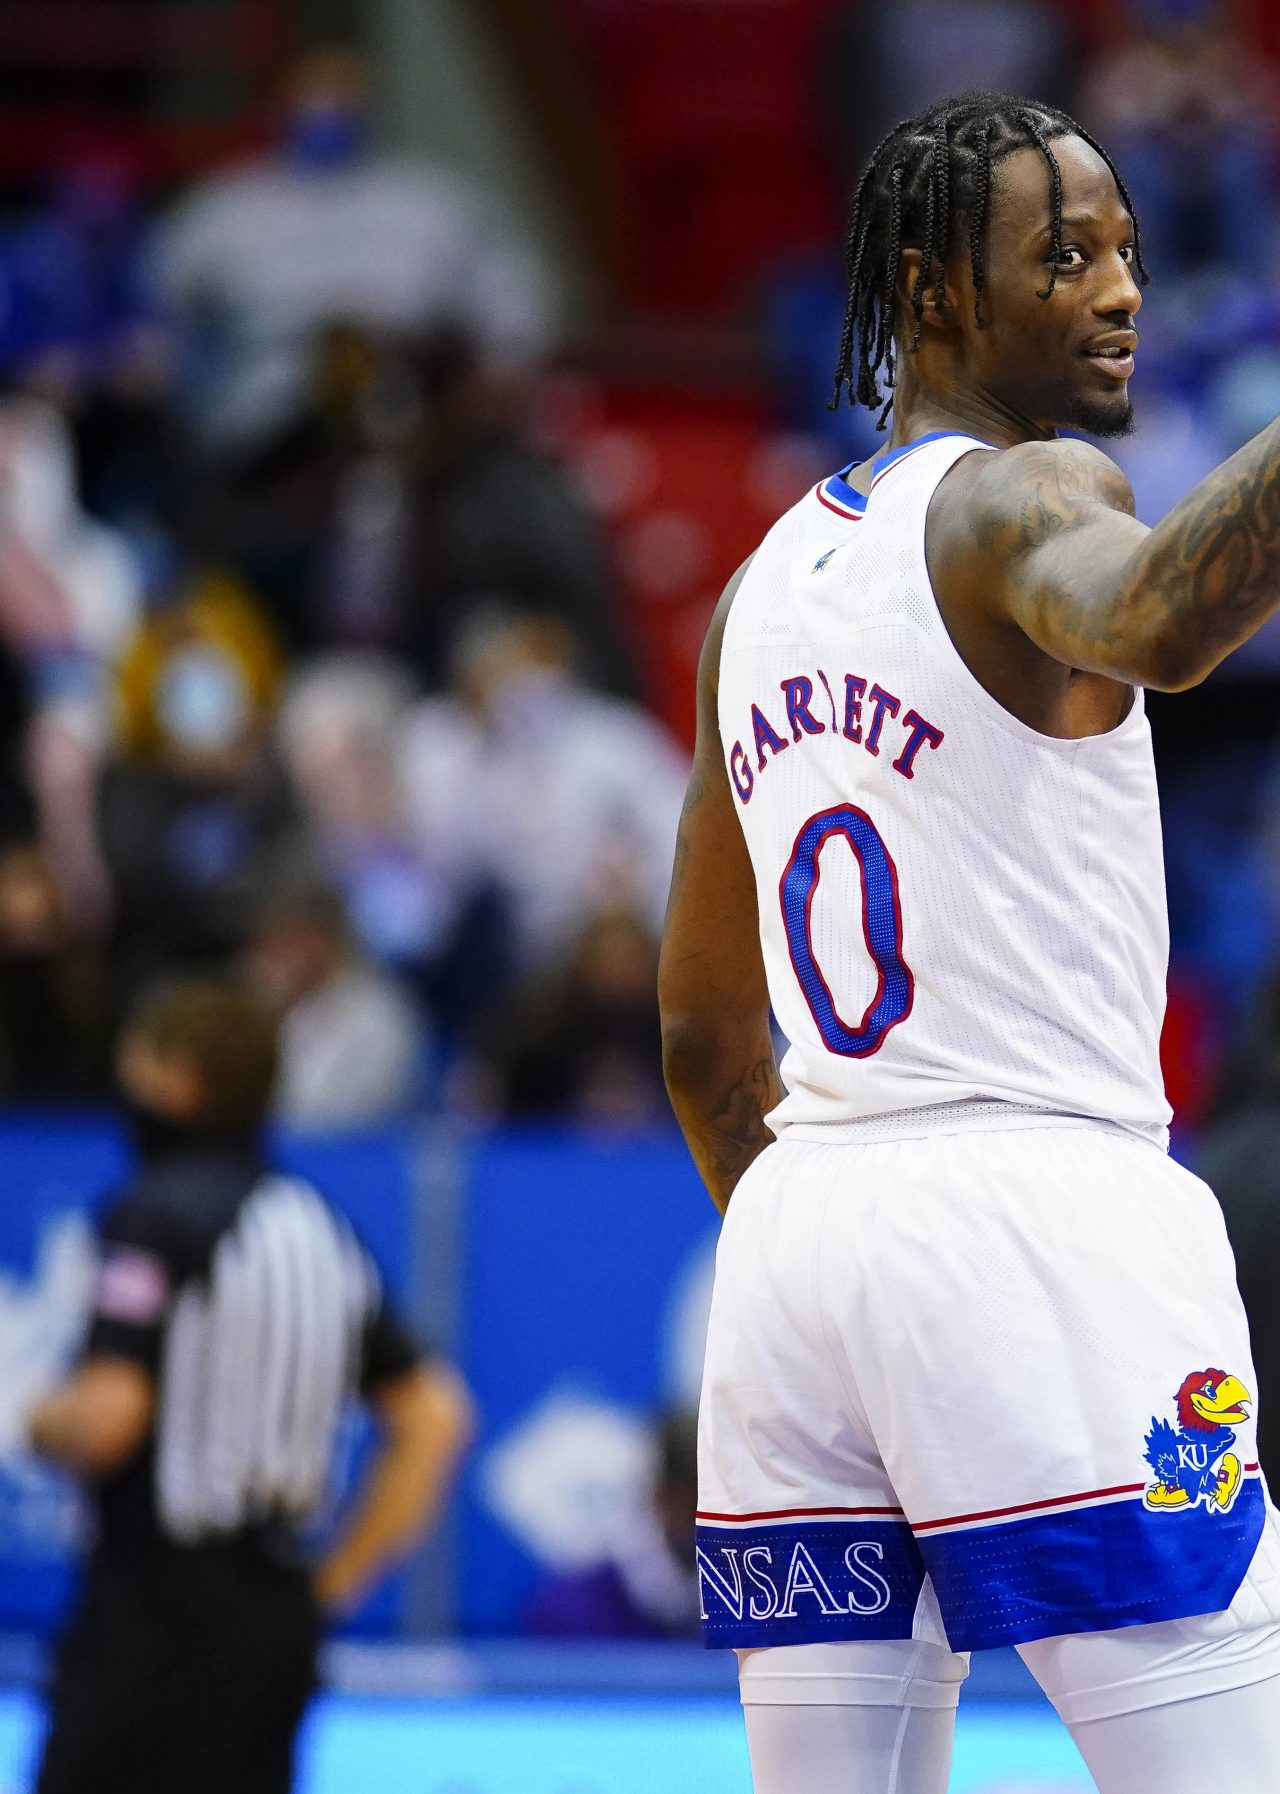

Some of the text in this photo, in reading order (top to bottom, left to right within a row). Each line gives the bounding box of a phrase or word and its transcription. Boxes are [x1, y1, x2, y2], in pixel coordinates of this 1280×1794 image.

[729, 669, 945, 805] GARETT
[779, 802, 915, 1059] 0
[1176, 1443, 1208, 1472] KU
